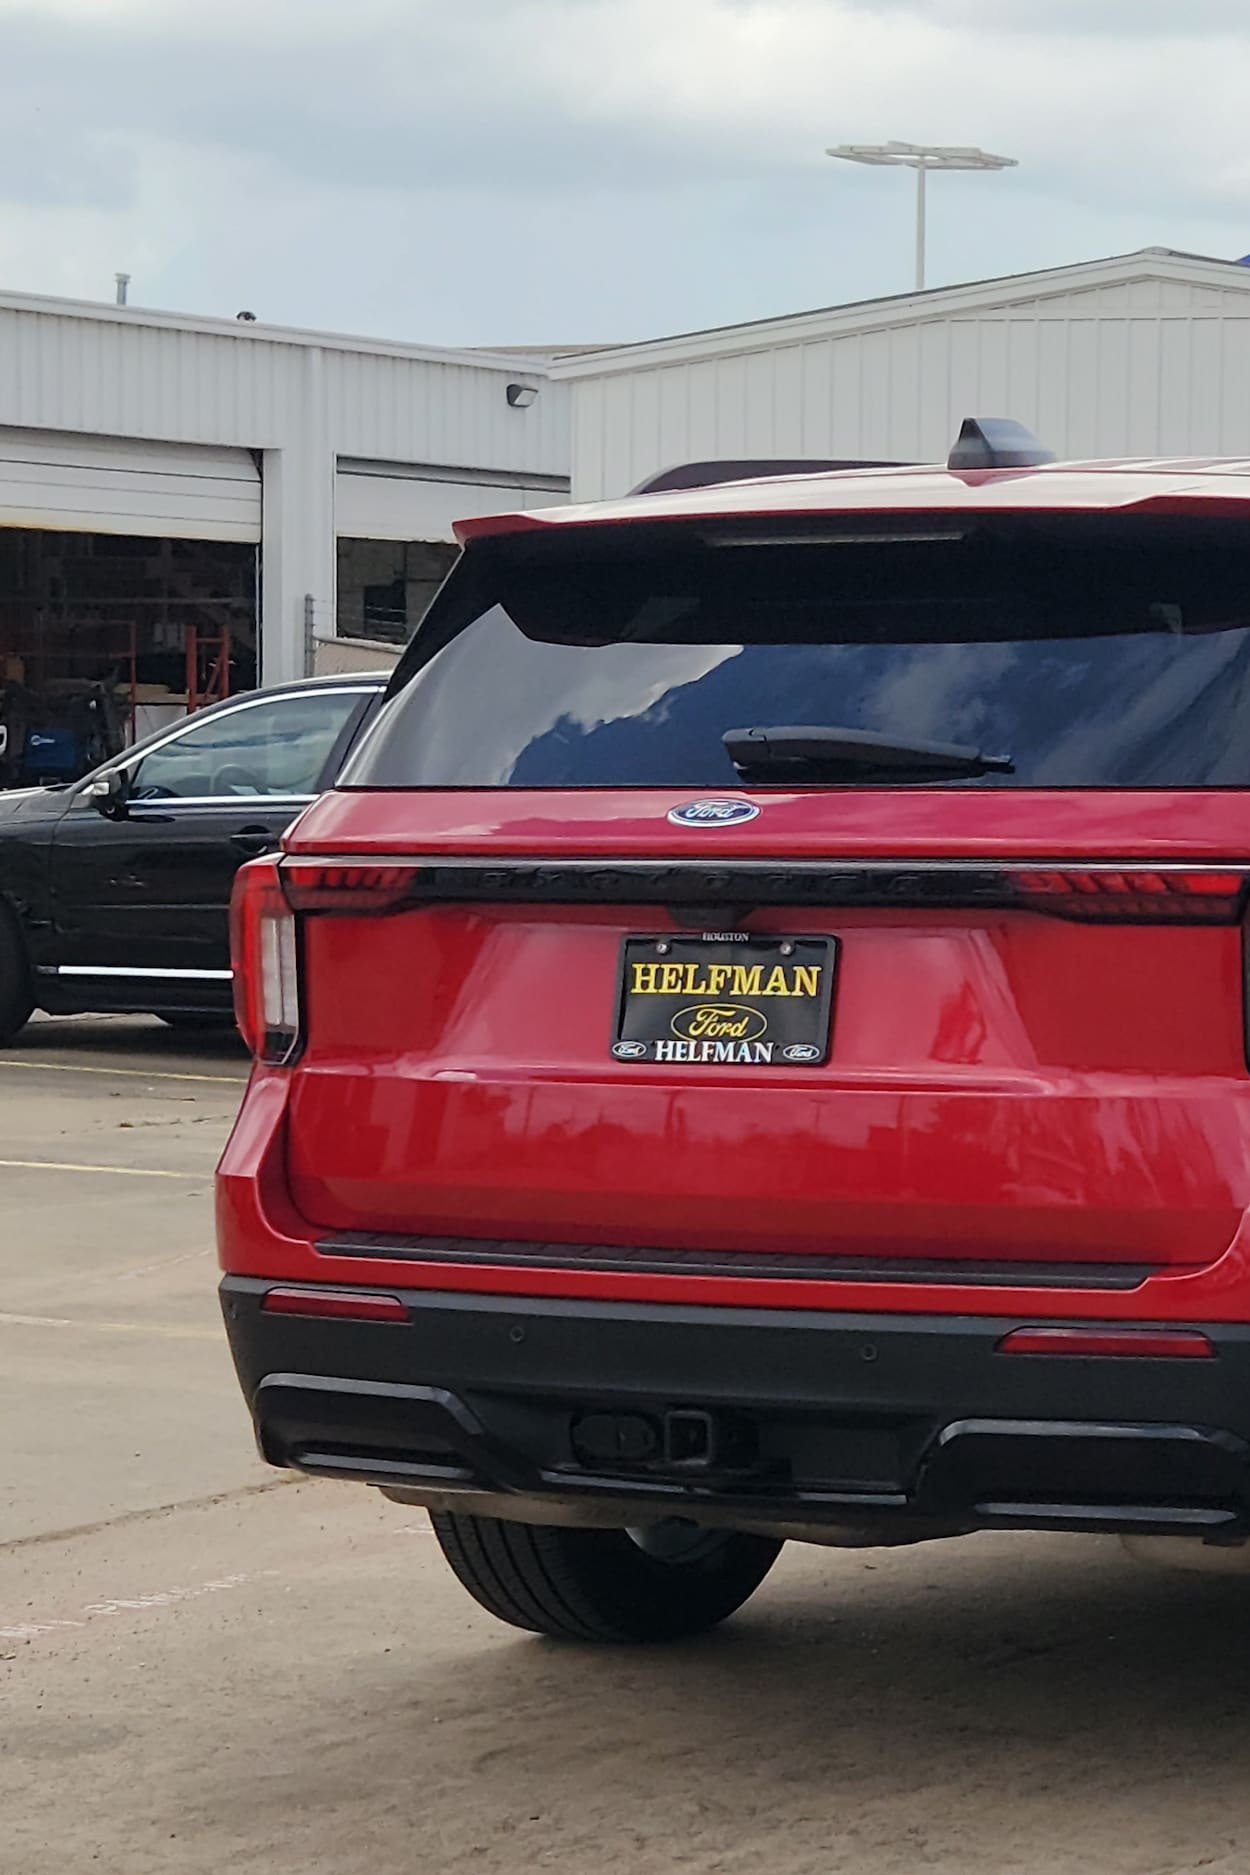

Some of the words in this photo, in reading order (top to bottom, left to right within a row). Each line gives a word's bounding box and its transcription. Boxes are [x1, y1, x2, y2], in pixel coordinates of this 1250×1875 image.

[685, 801, 741, 818] Ford
[631, 963, 822, 997] HELFMAN
[688, 1007, 749, 1038] Ford
[654, 1039, 775, 1063] HELFMAN
